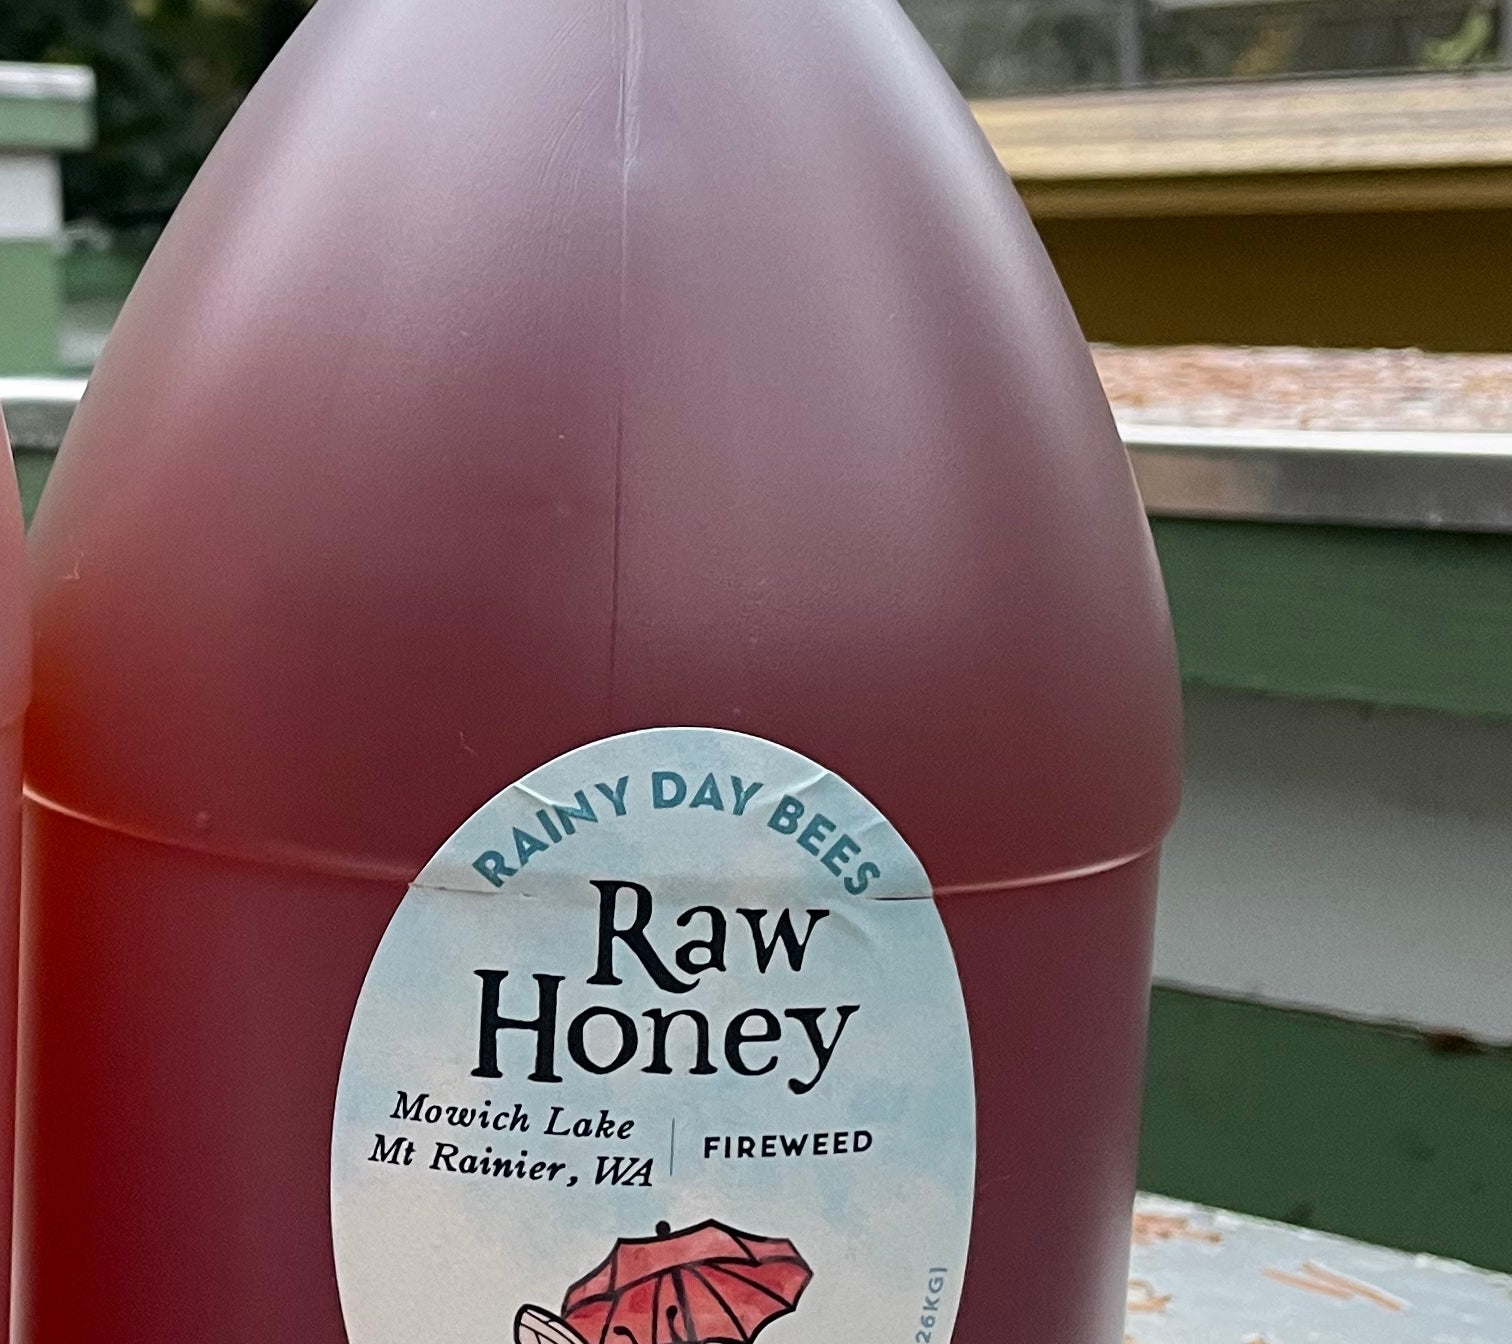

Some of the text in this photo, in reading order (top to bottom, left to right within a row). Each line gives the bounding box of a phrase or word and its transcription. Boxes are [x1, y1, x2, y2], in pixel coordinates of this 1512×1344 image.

[472, 771, 881, 896] RAINY DAY BEES
[588, 879, 830, 994] Raw
[470, 969, 860, 1095] Honey
[390, 1091, 635, 1140] Mowich Lake
[703, 1130, 873, 1159] FIREWEED
[368, 1134, 654, 1188] Mt Rainier, WA
